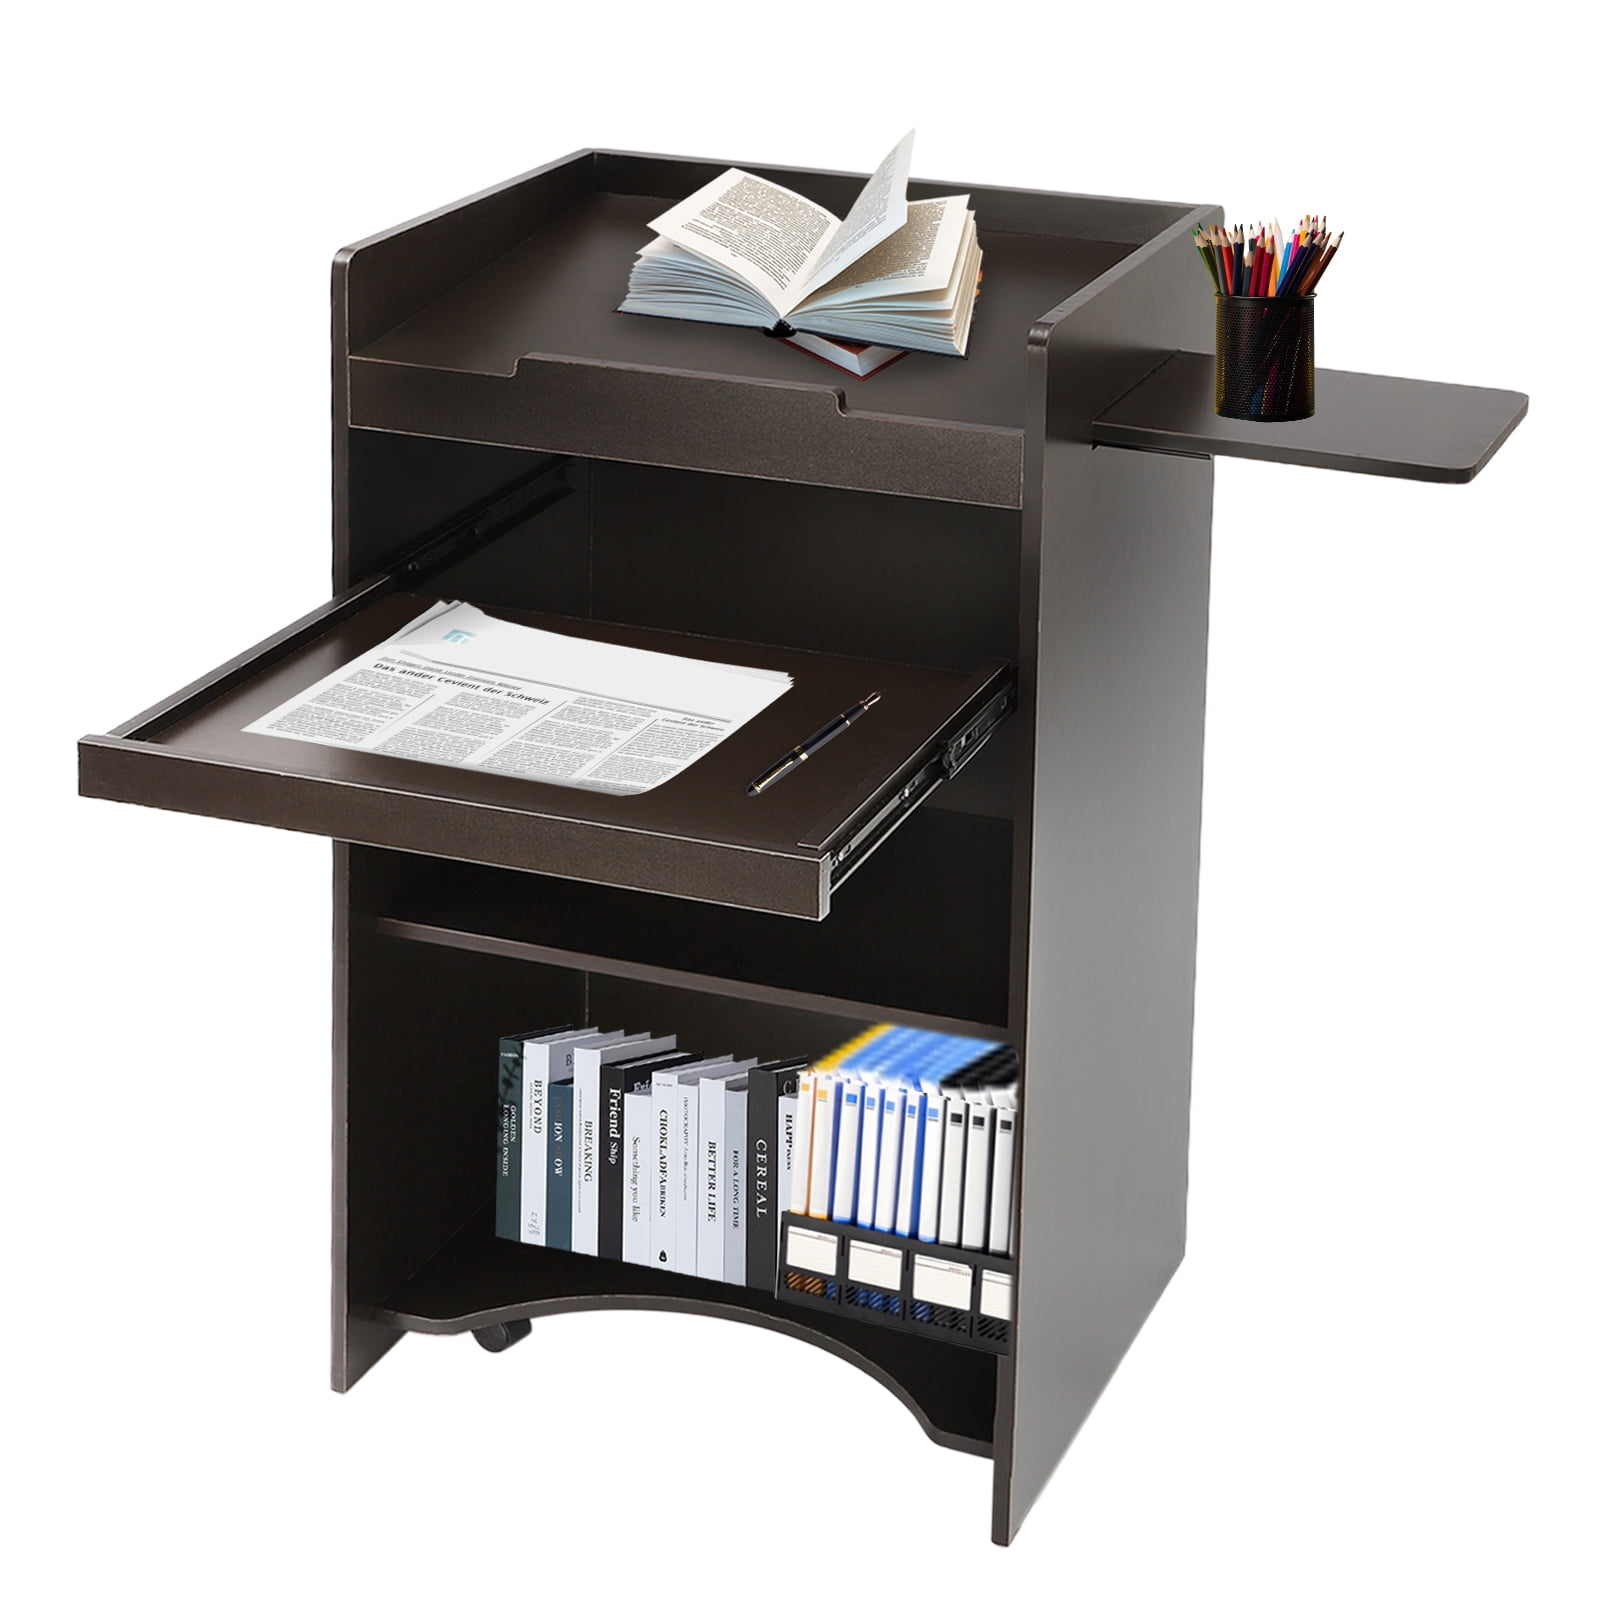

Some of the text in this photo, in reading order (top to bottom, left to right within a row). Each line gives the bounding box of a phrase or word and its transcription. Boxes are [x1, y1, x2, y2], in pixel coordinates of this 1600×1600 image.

[533, 1079, 542, 1134] BEYOND
[607, 1088, 621, 1165] Friend Ship
[584, 1120, 593, 1182] BREAKING
[630, 1136, 640, 1222] Something you like
[708, 1140, 717, 1222] BETTER LIFE
[755, 1138, 768, 1218] CEREAL
